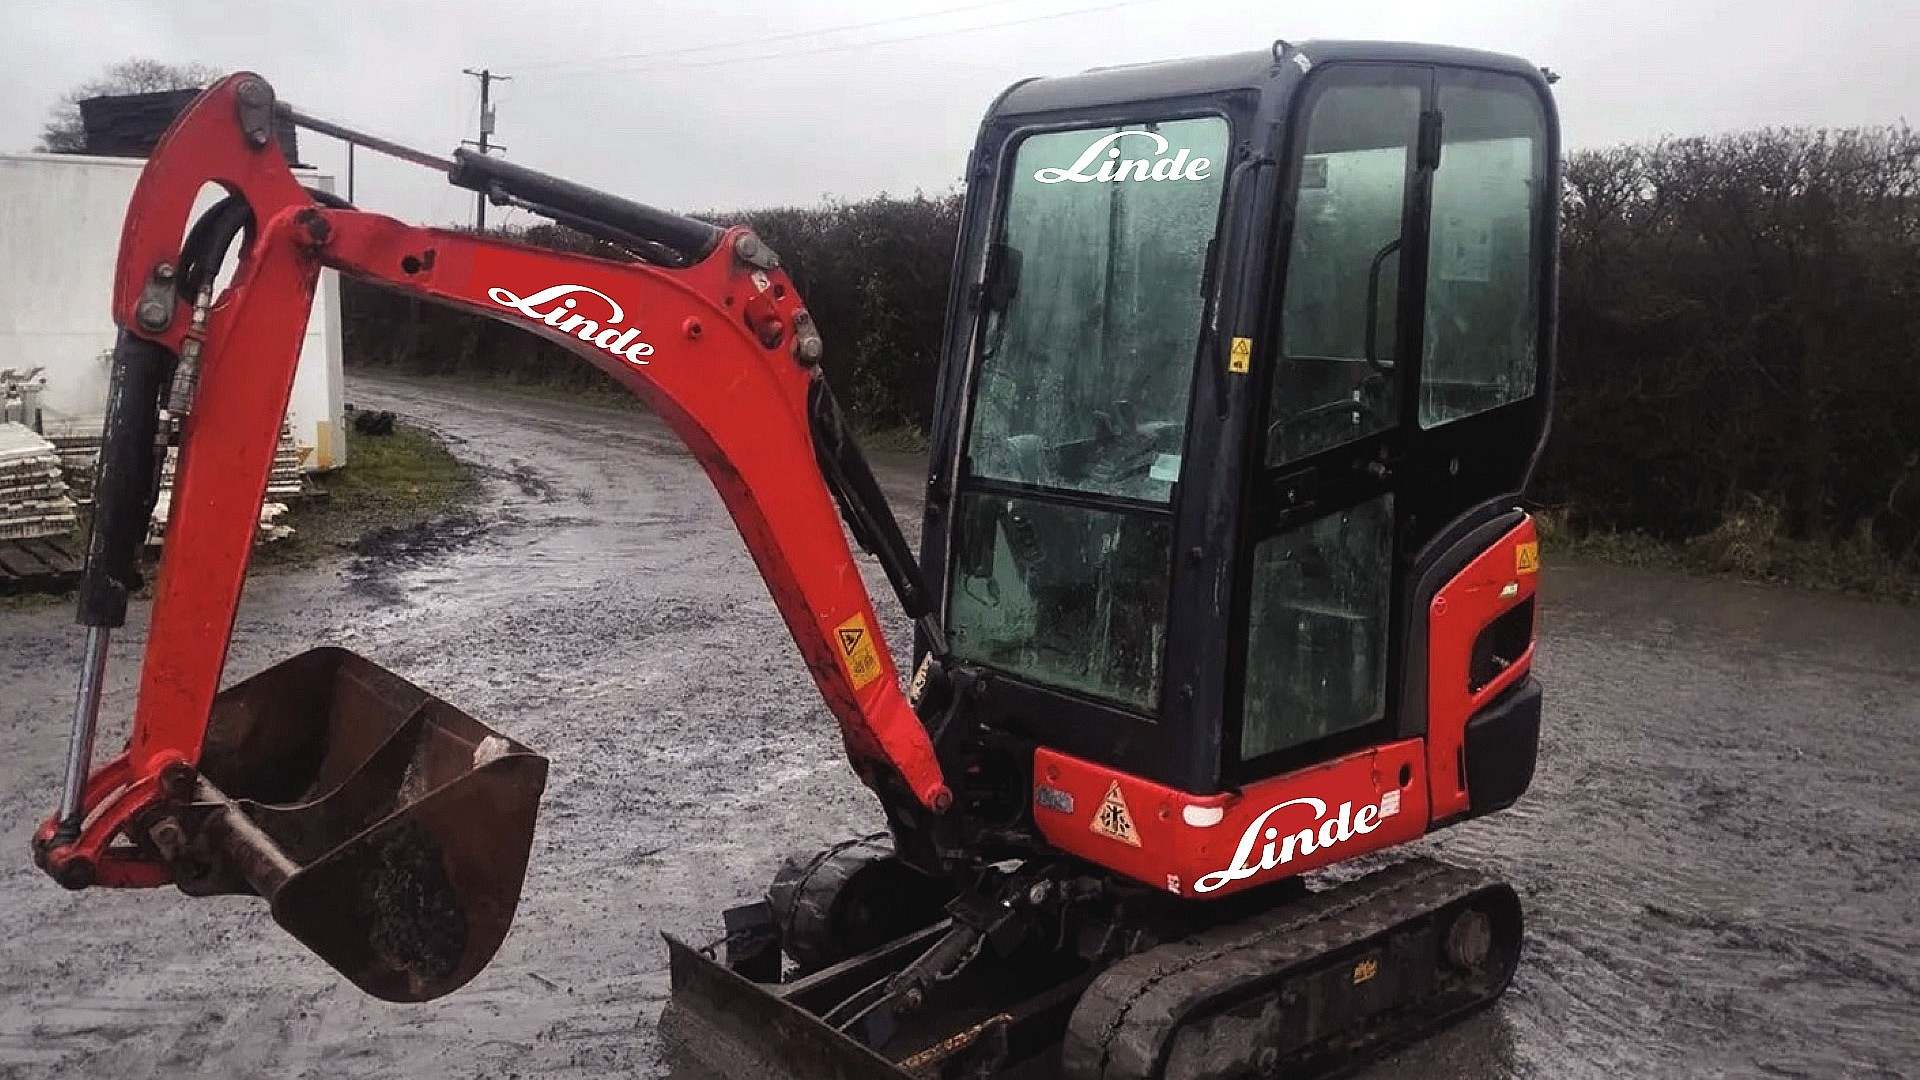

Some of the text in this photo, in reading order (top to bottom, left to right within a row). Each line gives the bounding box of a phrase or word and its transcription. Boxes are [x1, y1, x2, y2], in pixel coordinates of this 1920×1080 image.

[1033, 130, 1211, 184] Linde
[487, 284, 655, 365] Linde
[1193, 797, 1383, 893] Linde
